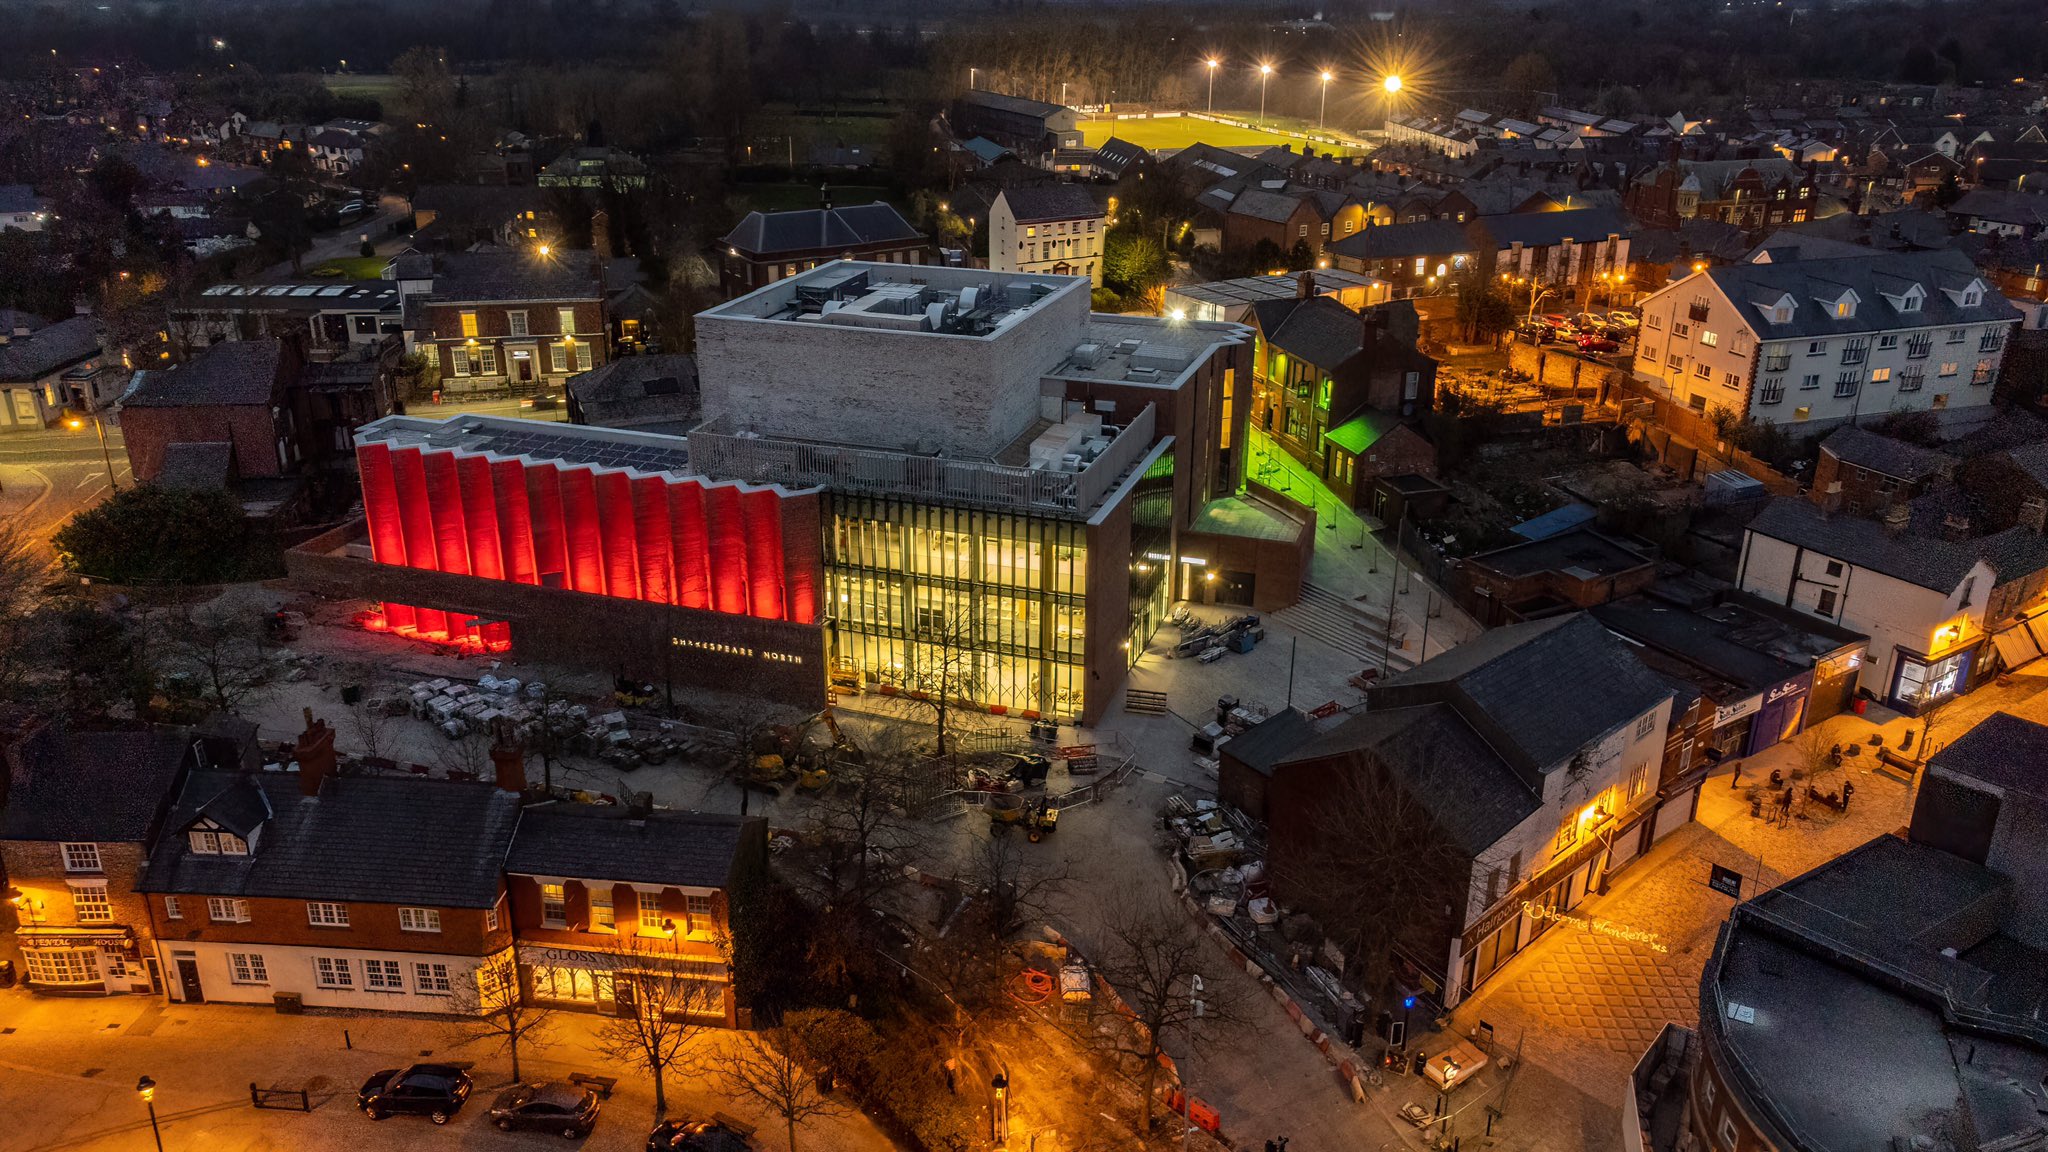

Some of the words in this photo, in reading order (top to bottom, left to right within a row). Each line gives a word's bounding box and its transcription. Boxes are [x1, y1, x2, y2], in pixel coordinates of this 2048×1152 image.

[672, 637, 753, 657] SHAKESPEARE
[763, 651, 802, 664] NORTH
[1476, 896, 1520, 939] Hairport
[546, 949, 597, 963] GLOSS
